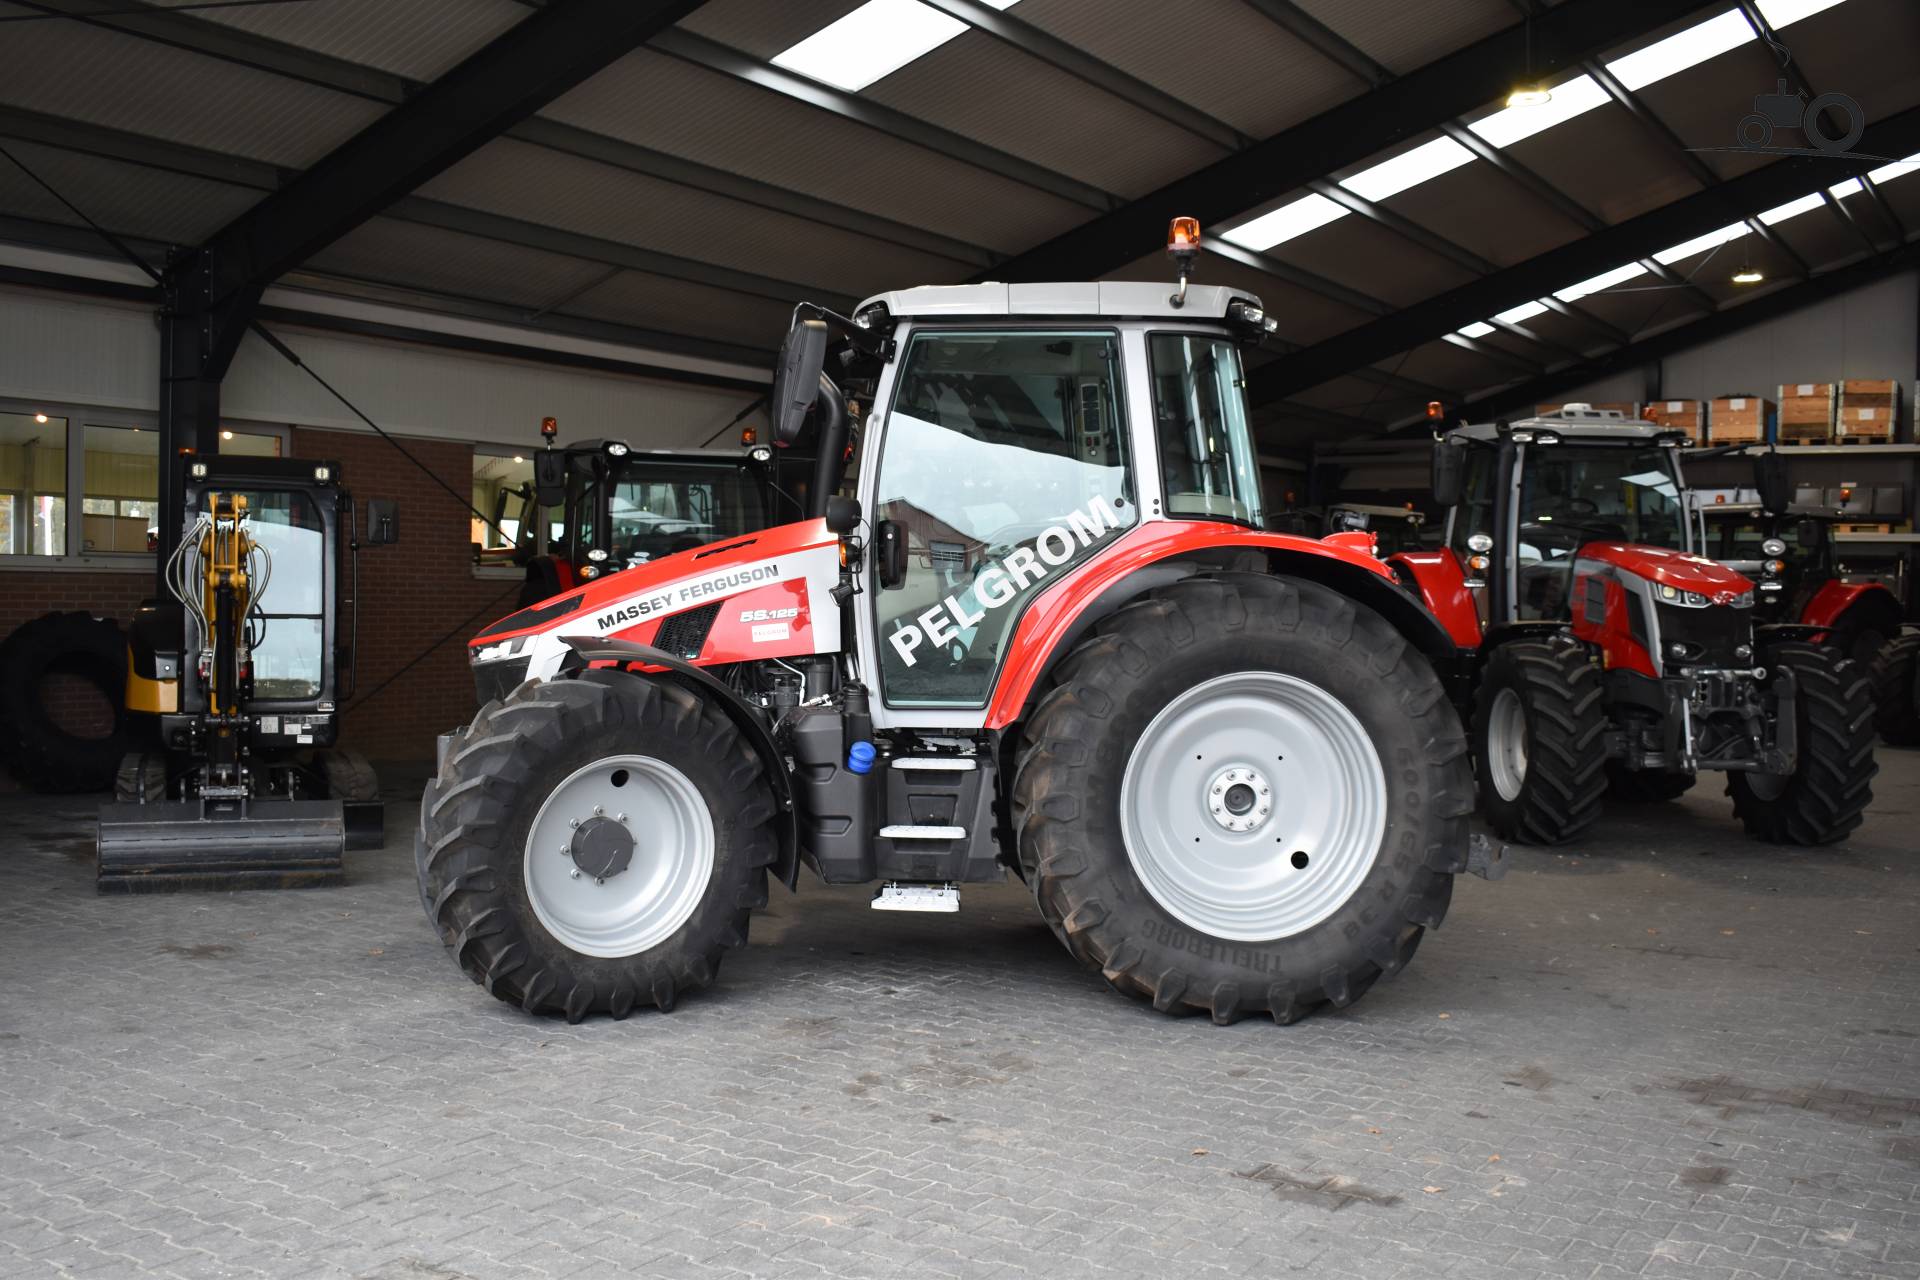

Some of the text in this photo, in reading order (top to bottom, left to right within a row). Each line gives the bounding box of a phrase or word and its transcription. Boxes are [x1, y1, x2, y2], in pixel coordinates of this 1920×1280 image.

[597, 564, 780, 630] MASSEY FERGUSON
[889, 494, 1120, 667] PELGROM
[1141, 918, 1285, 976] TRELLEBORG
